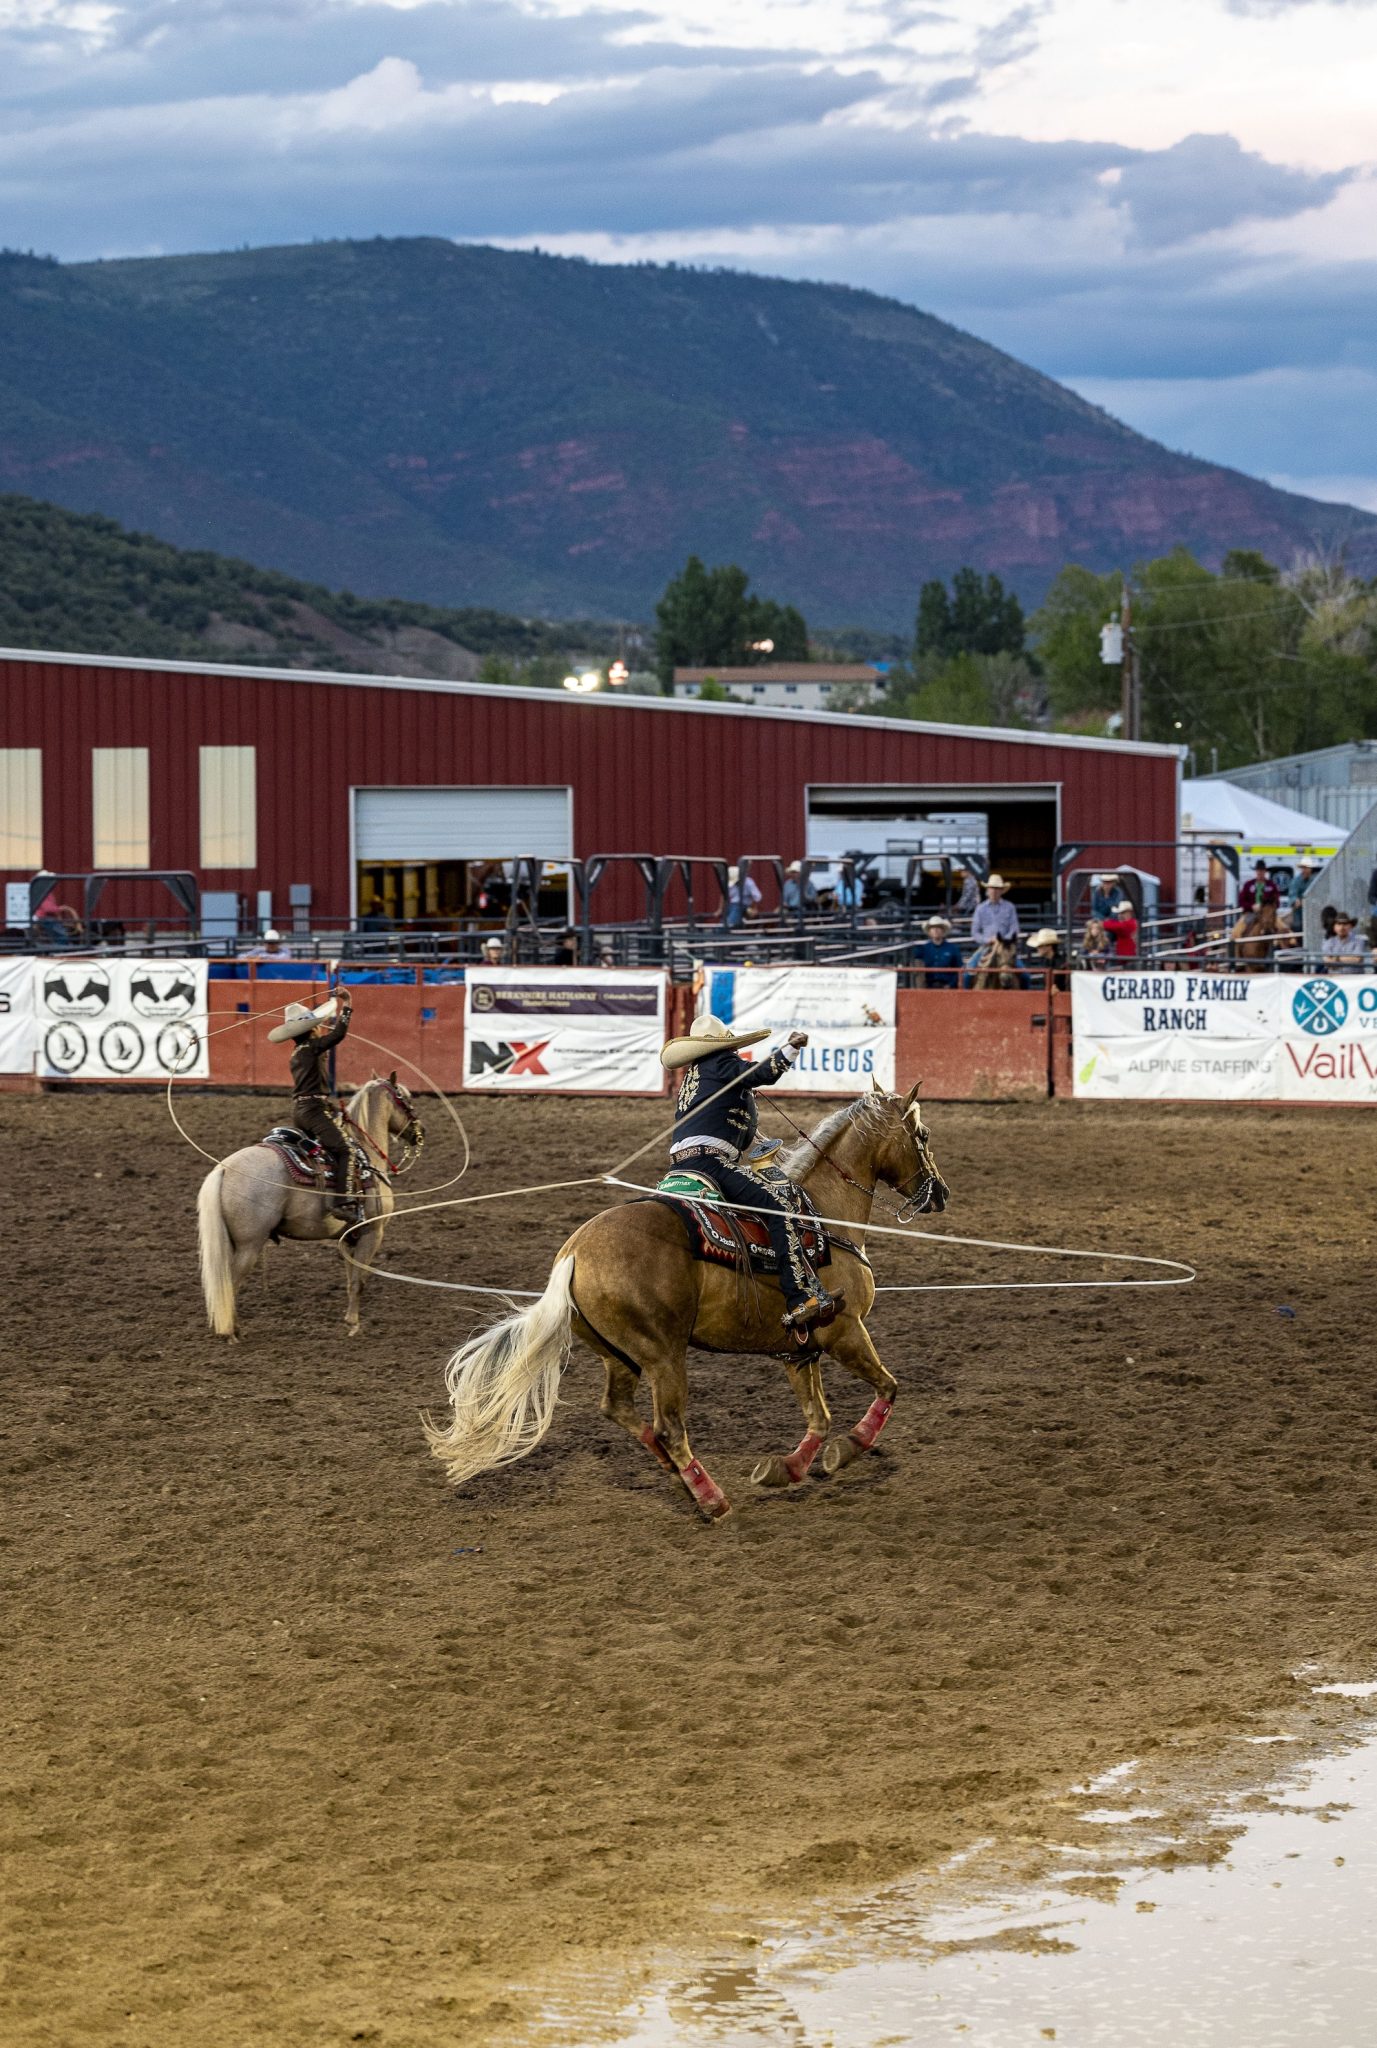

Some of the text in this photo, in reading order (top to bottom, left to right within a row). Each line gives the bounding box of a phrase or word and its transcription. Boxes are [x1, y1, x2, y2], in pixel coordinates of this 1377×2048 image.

[1102, 976, 1250, 1001] GERARD FAMILY
[1143, 1007, 1208, 1031] RANCH
[1128, 1058, 1271, 1074] ALPINE STAFFING
